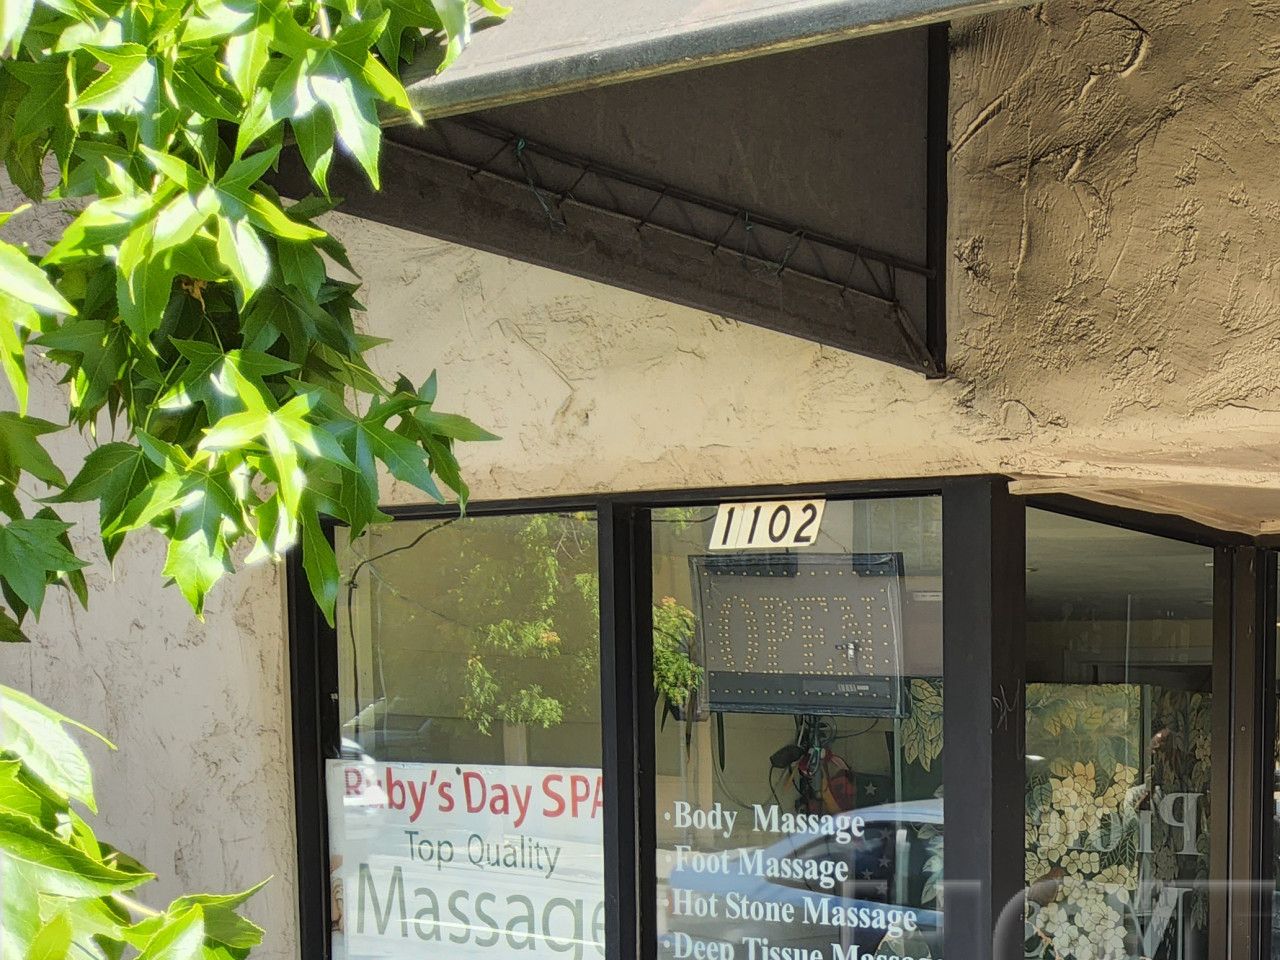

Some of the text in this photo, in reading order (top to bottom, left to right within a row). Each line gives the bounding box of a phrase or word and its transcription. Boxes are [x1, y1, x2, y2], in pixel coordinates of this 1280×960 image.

[721, 502, 818, 546] 1102
[462, 771, 533, 828] Day
[673, 800, 865, 844] Body Massage
[404, 830, 561, 879] Top Quality
[674, 844, 849, 889] Foot Massage
[672, 888, 918, 938] Hot Stone Massage
